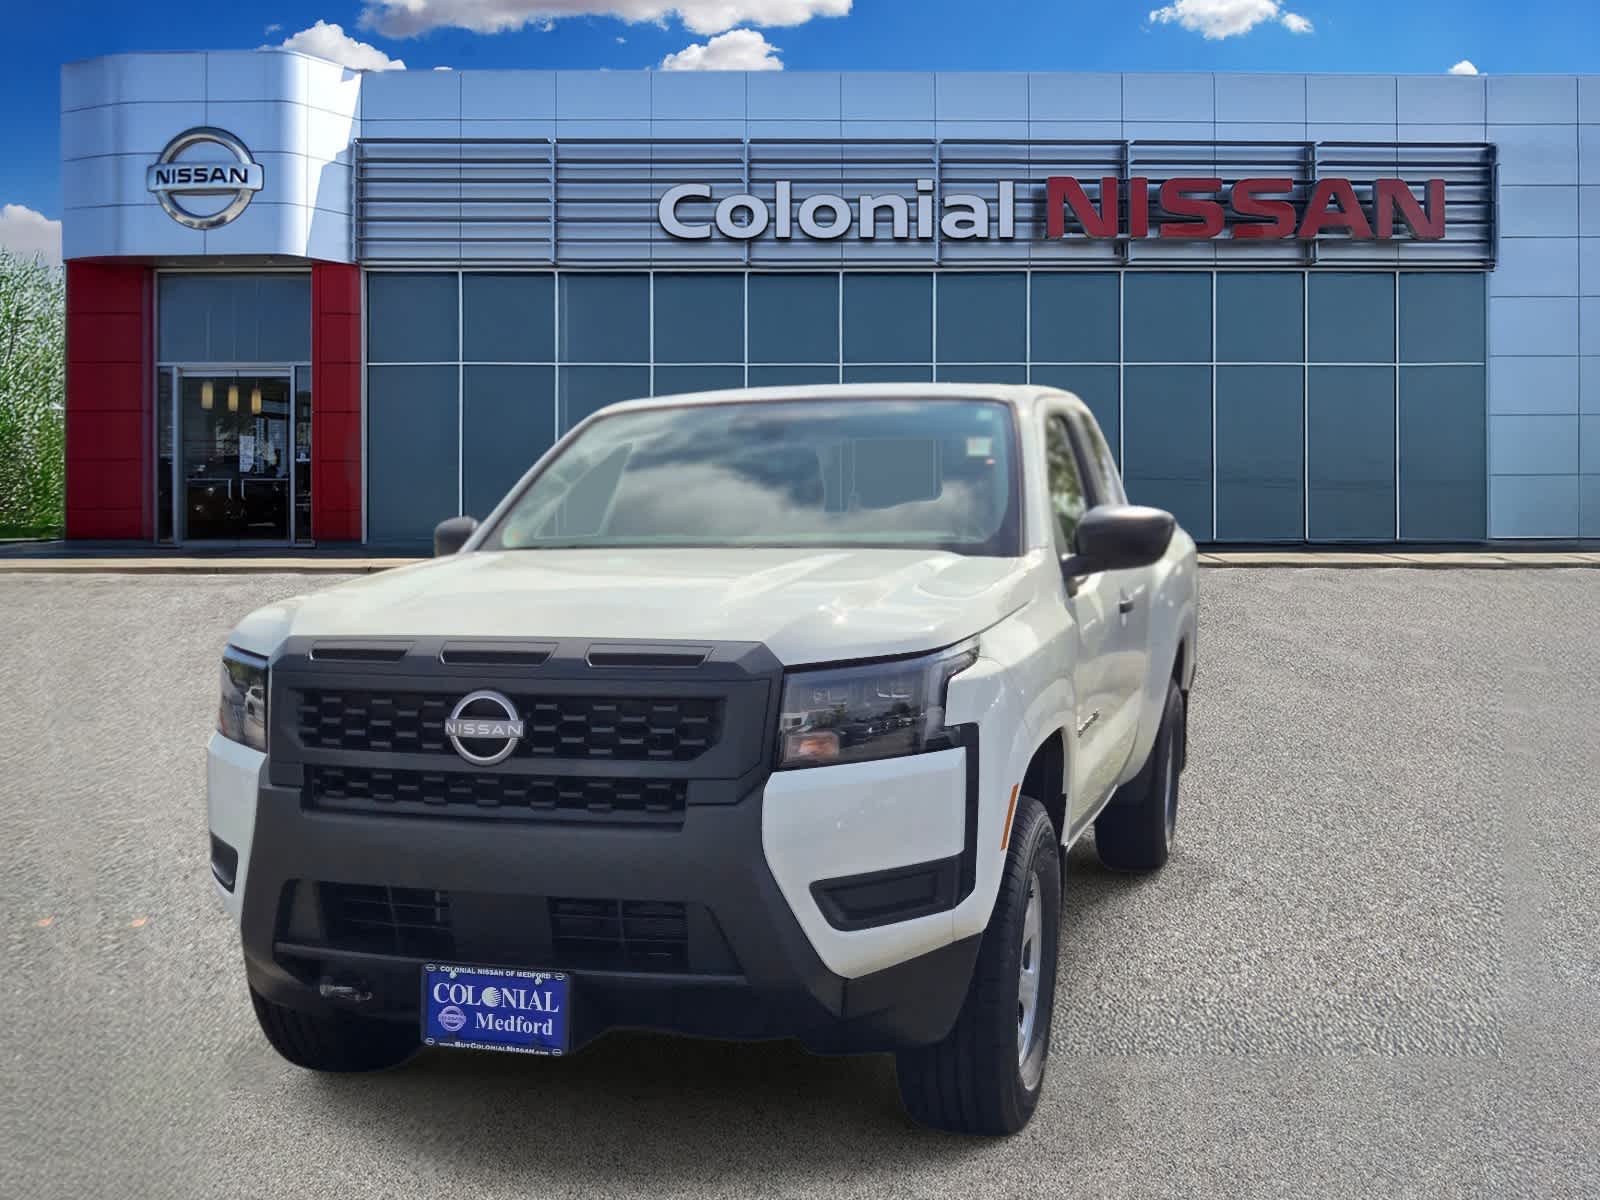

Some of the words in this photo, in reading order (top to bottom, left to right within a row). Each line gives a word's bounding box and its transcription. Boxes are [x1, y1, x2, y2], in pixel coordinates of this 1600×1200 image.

[155, 167, 248, 184] NISSAN
[658, 179, 1015, 240] Colonial
[1046, 176, 1446, 240] NISSAN
[445, 722, 522, 736] NISSAN
[440, 965, 476, 975] COLONIAL
[477, 968, 504, 977] NISSAN
[516, 971, 551, 979] MEDFORD
[433, 982, 559, 1013] COLONIAL
[475, 1012, 553, 1036] Medford
